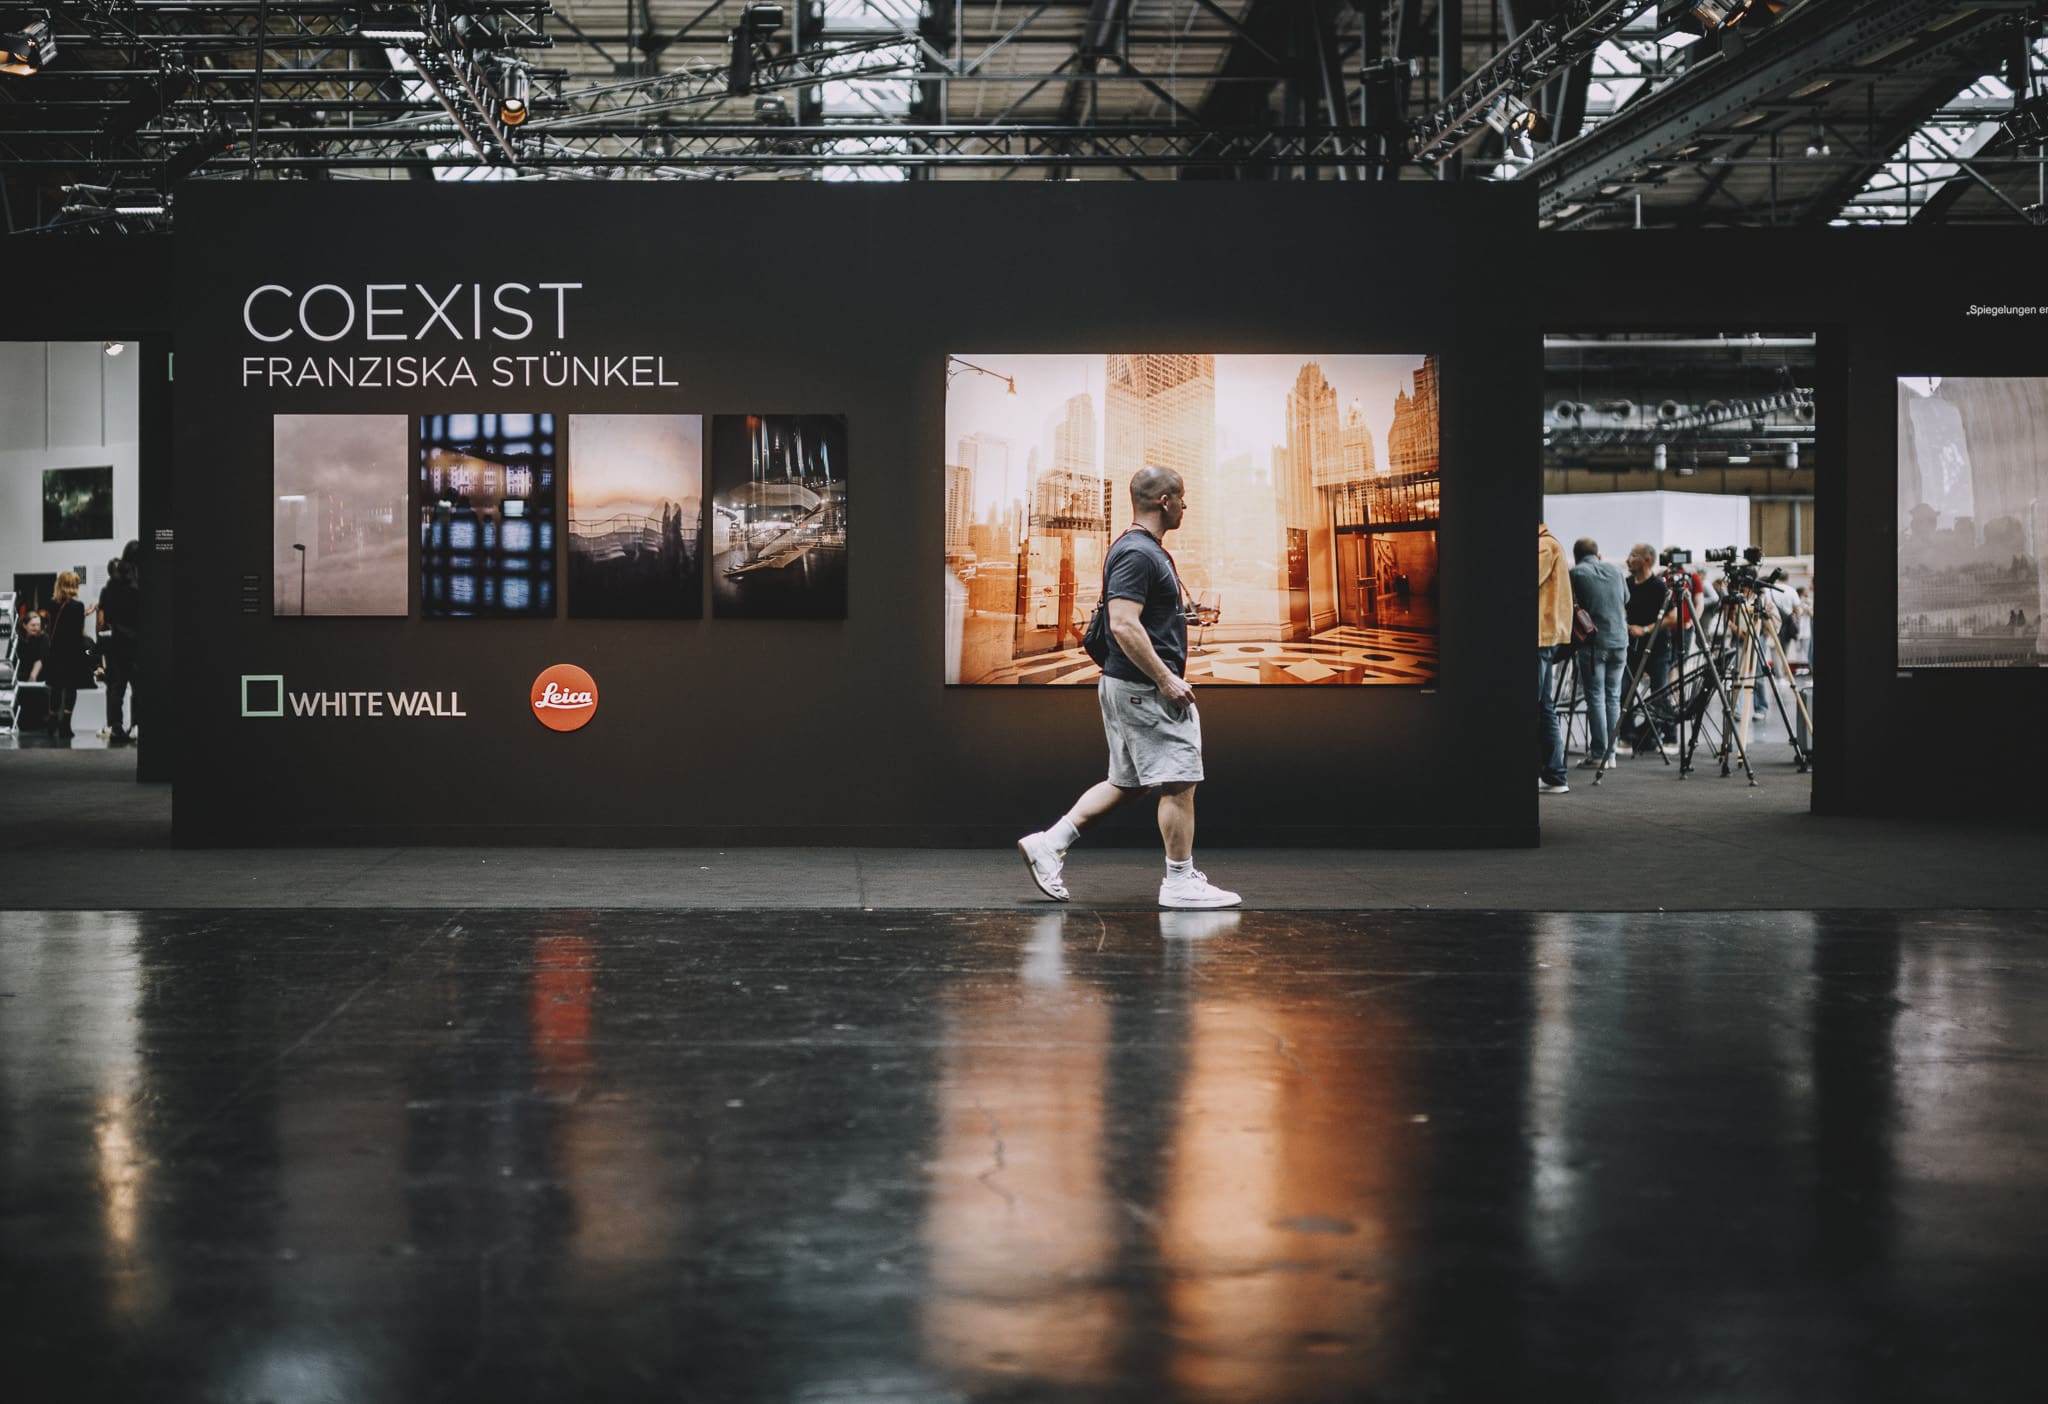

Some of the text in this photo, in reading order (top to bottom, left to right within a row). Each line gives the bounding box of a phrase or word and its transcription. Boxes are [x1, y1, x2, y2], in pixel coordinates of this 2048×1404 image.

[243, 282, 583, 343] COEXIST
[1966, 304, 2037, 316] „Spiegelungen
[243, 350, 680, 388] FRANZISKA STÜNKEL
[534, 682, 594, 710] Leica
